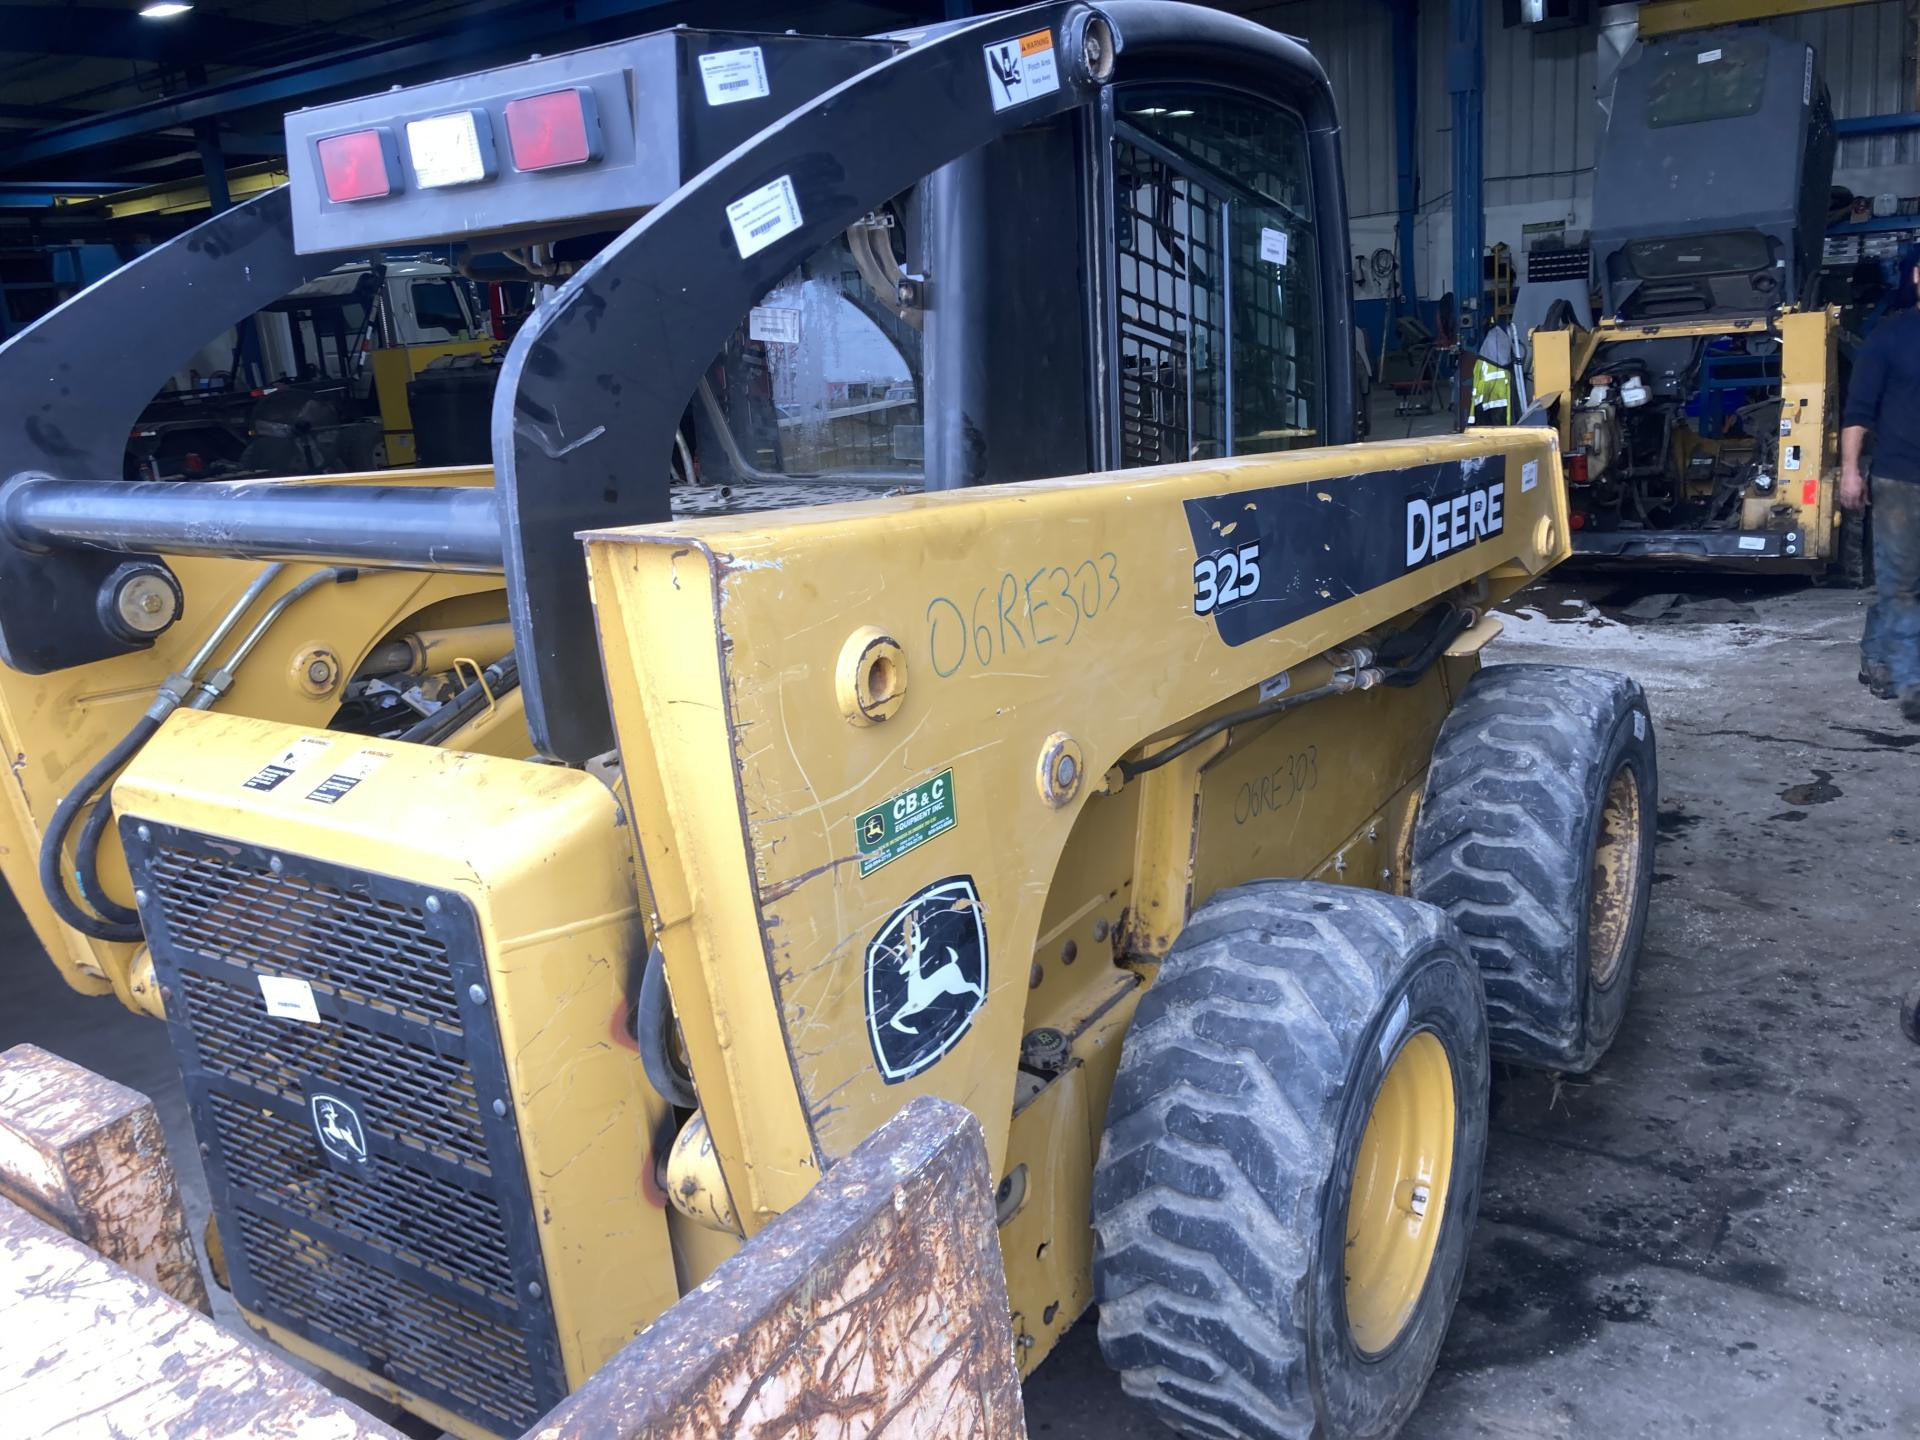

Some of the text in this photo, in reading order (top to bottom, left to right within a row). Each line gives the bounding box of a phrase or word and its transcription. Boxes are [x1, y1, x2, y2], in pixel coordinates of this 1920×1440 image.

[1026, 36, 1050, 48] WARNING
[1405, 482, 1504, 567] DEERE
[1194, 544, 1261, 612] 325
[926, 551, 1121, 679] 06RE303
[894, 807, 931, 833] EQUIPMENT
[931, 801, 945, 814] INC.
[921, 792, 930, 807] &
[931, 779, 944, 800] C
[1234, 745, 1318, 825] 06RE303
